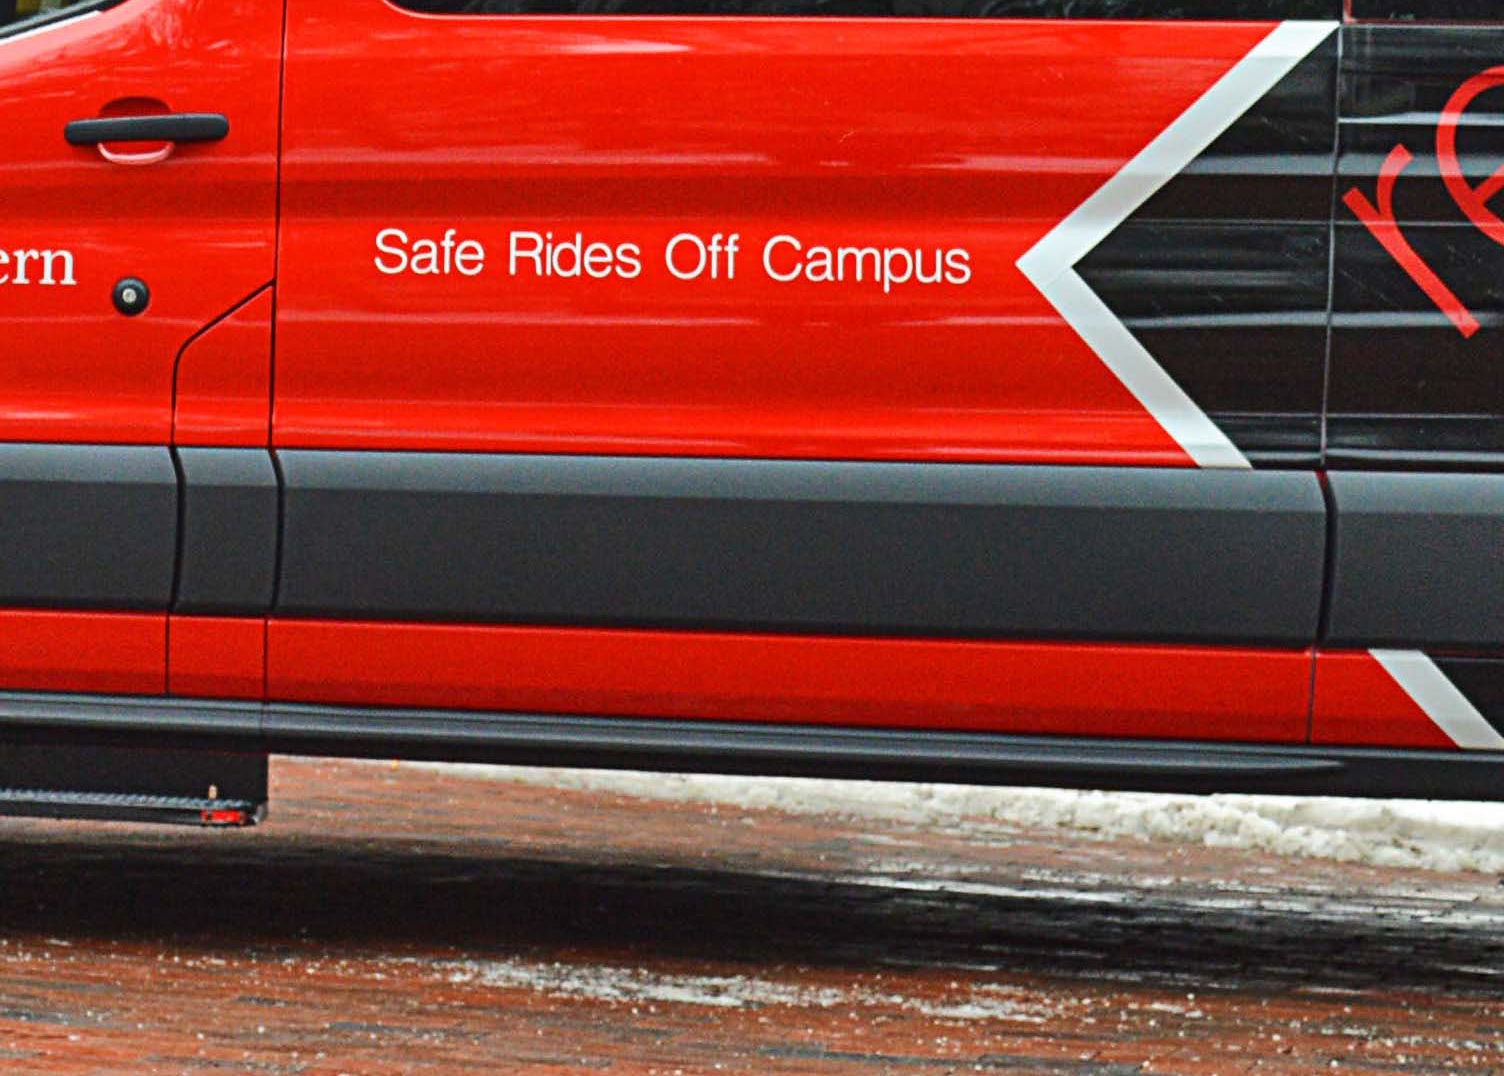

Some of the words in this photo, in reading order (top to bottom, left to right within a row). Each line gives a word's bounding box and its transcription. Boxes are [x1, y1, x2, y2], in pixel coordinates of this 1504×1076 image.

[374, 228, 485, 275] Safe
[508, 230, 642, 279] Rides
[665, 232, 739, 281] Off
[762, 234, 972, 293] Campus
